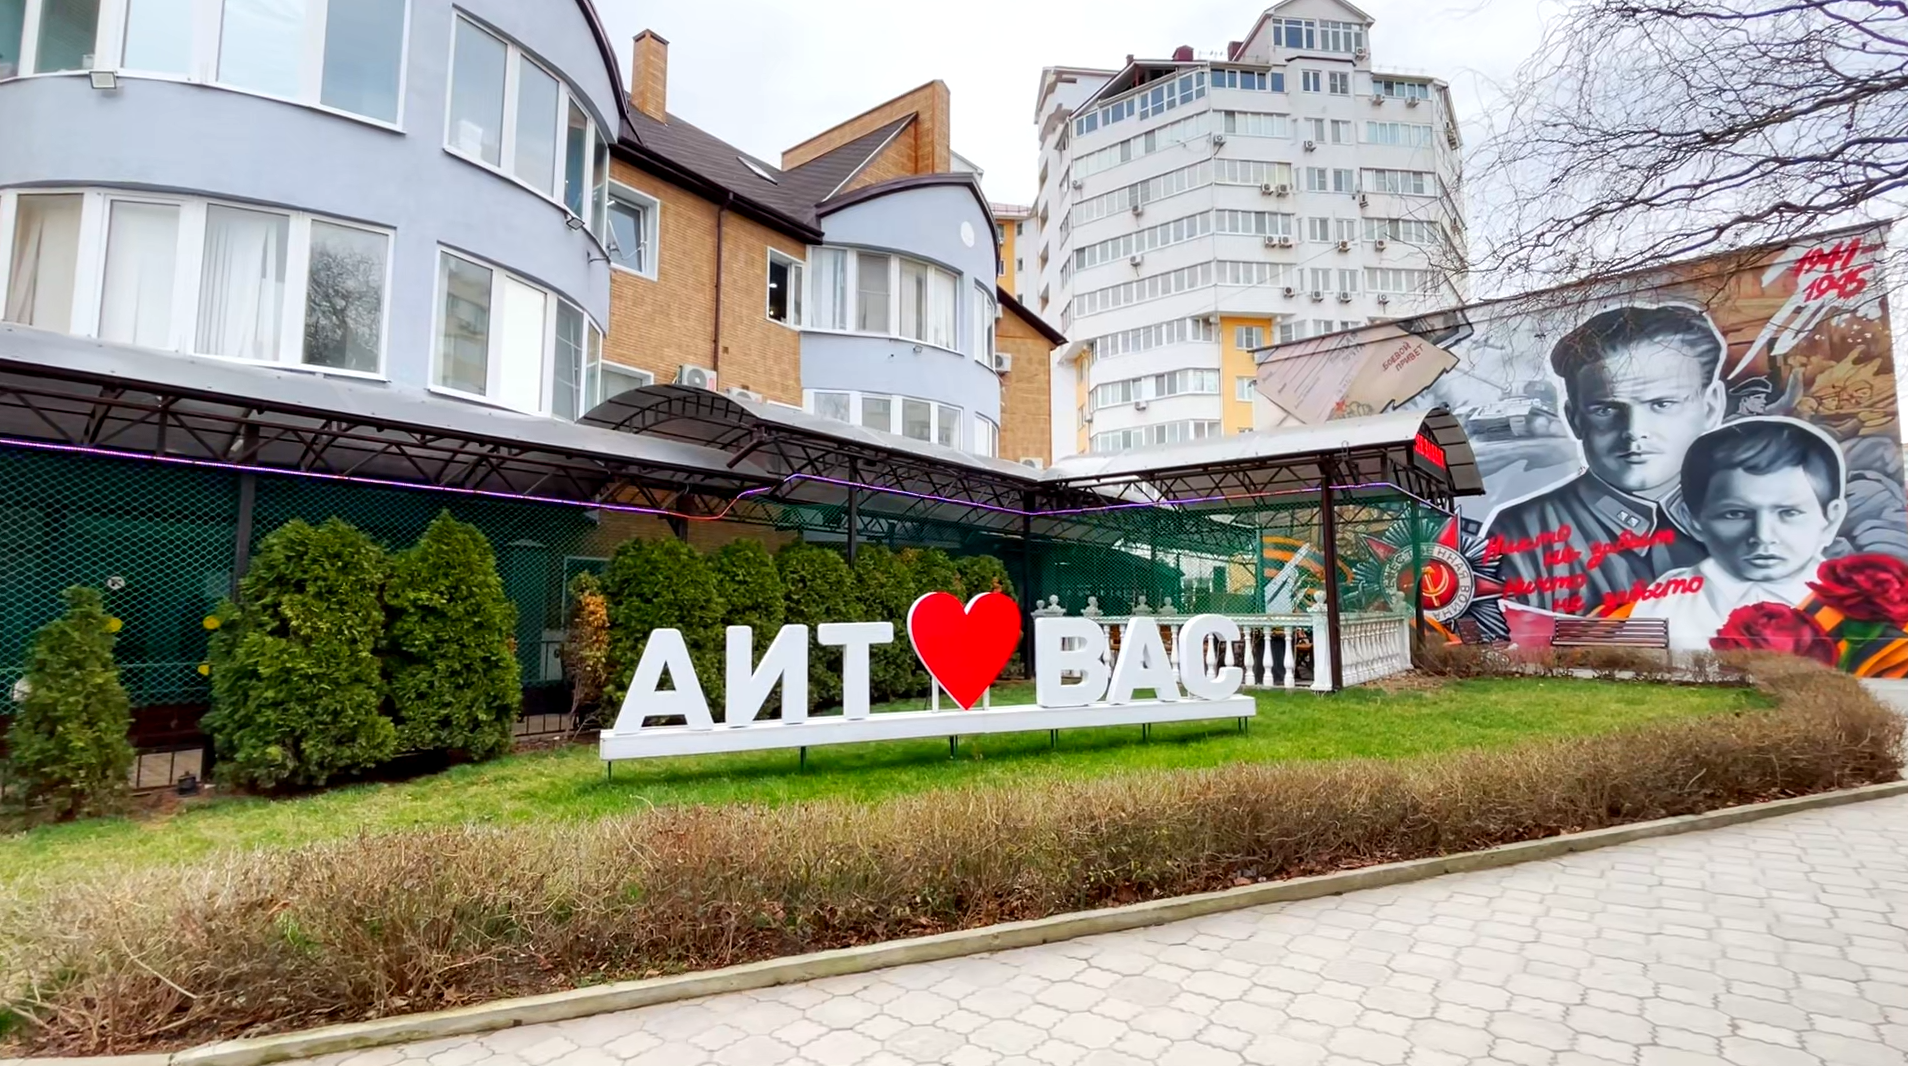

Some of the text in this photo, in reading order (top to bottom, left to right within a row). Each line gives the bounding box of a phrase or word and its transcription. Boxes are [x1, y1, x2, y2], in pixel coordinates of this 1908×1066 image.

[1802, 264, 1875, 303] 1945
[1382, 341, 1411, 371] БОЕВОЙ
[1395, 343, 1424, 371] ПРИВЕТ
[613, 613, 1243, 735] АИТ ВАС
